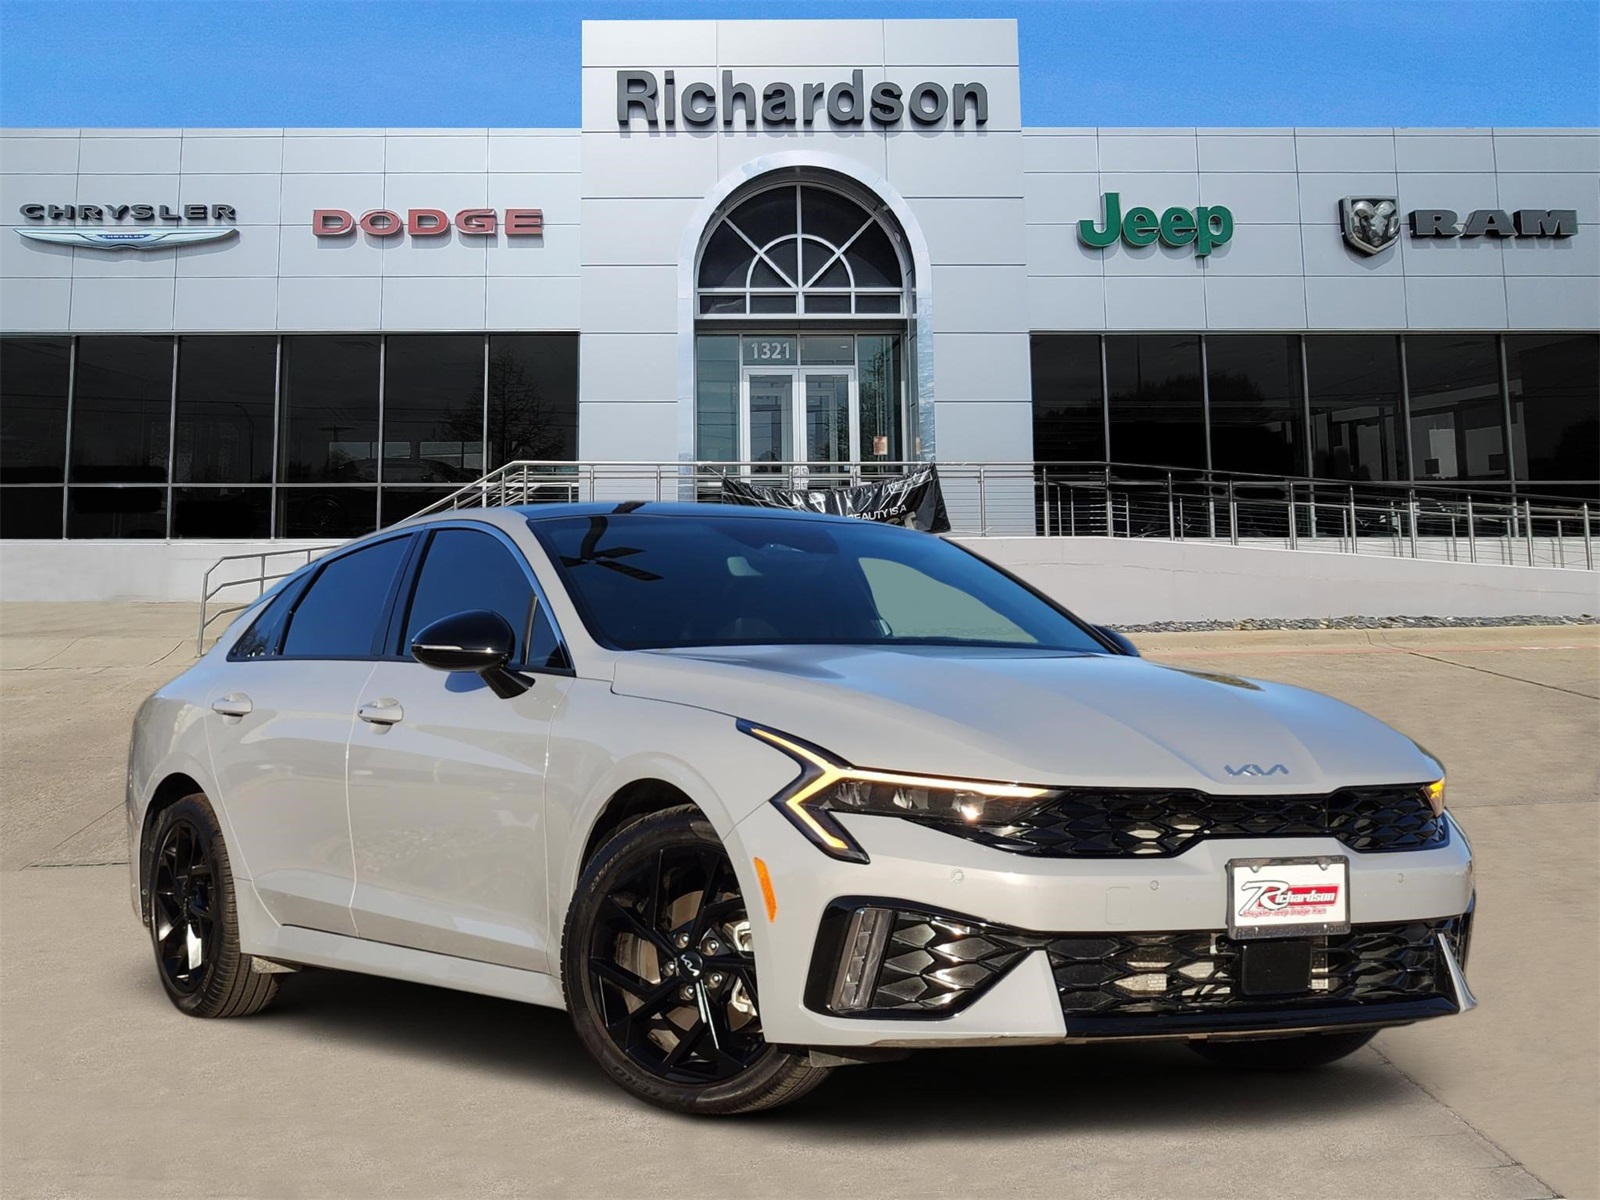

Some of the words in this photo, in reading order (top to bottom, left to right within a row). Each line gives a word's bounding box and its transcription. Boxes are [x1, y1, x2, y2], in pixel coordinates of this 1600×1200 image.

[617, 69, 988, 126] Richardson
[19, 203, 236, 220] CHRYSLER
[312, 208, 544, 237] DODGE
[1076, 192, 1235, 258] Jeep
[1409, 208, 1578, 238] RAM
[751, 342, 790, 359] 1321
[889, 506, 899, 516] IS
[900, 504, 907, 513] A
